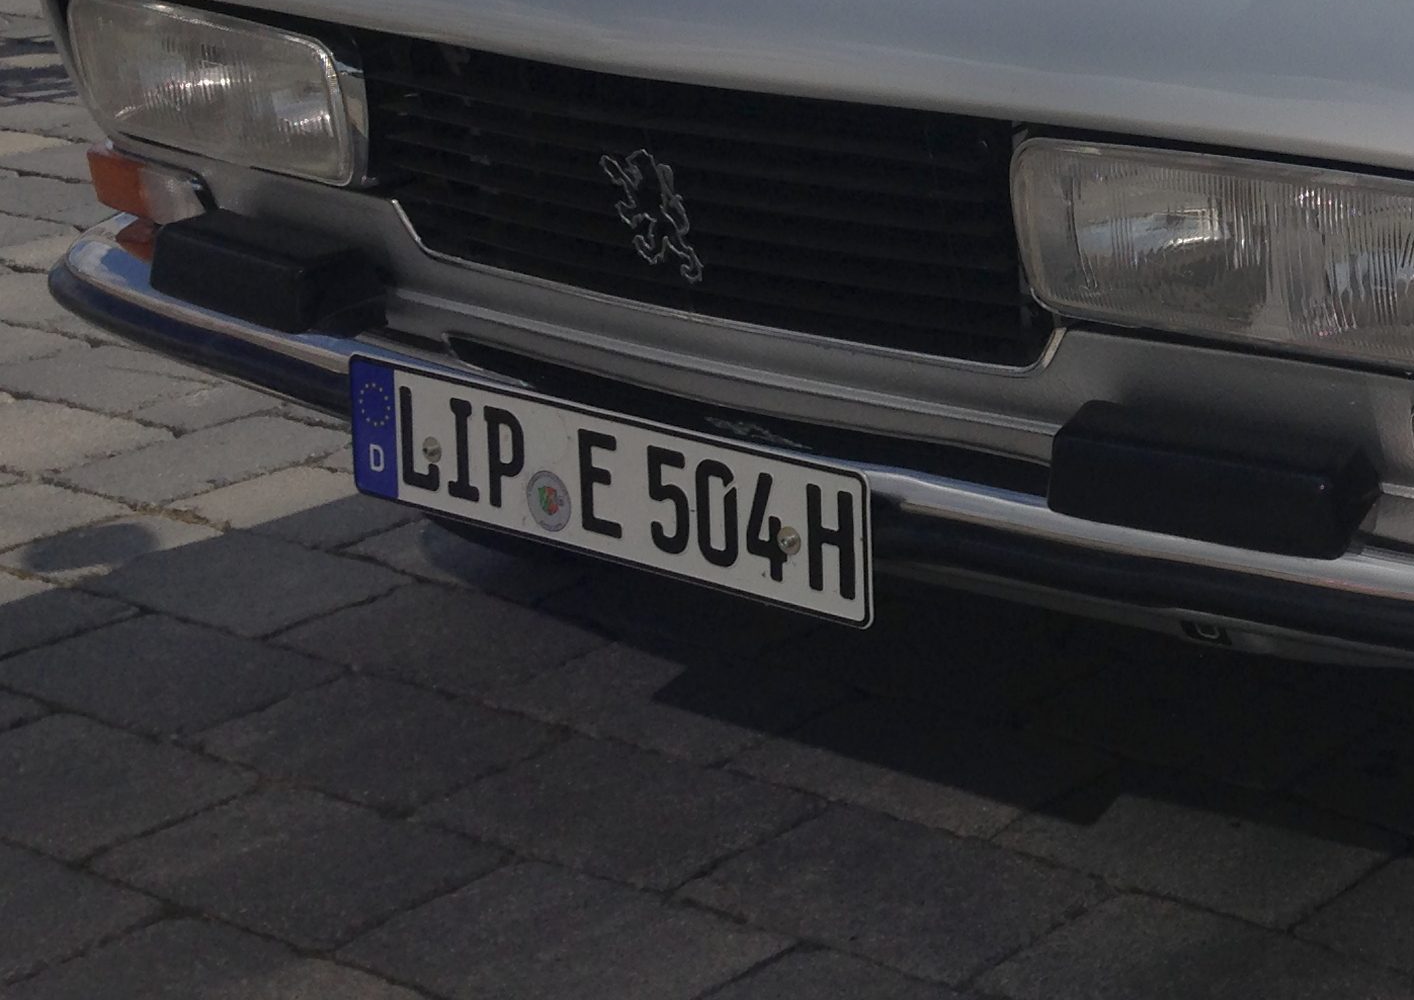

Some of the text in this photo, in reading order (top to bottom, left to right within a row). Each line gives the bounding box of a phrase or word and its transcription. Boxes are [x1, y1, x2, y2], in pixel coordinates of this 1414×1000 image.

[369, 443, 386, 473] D
[399, 385, 525, 508] LIP
[577, 428, 623, 539] E
[647, 444, 856, 600] 504H
